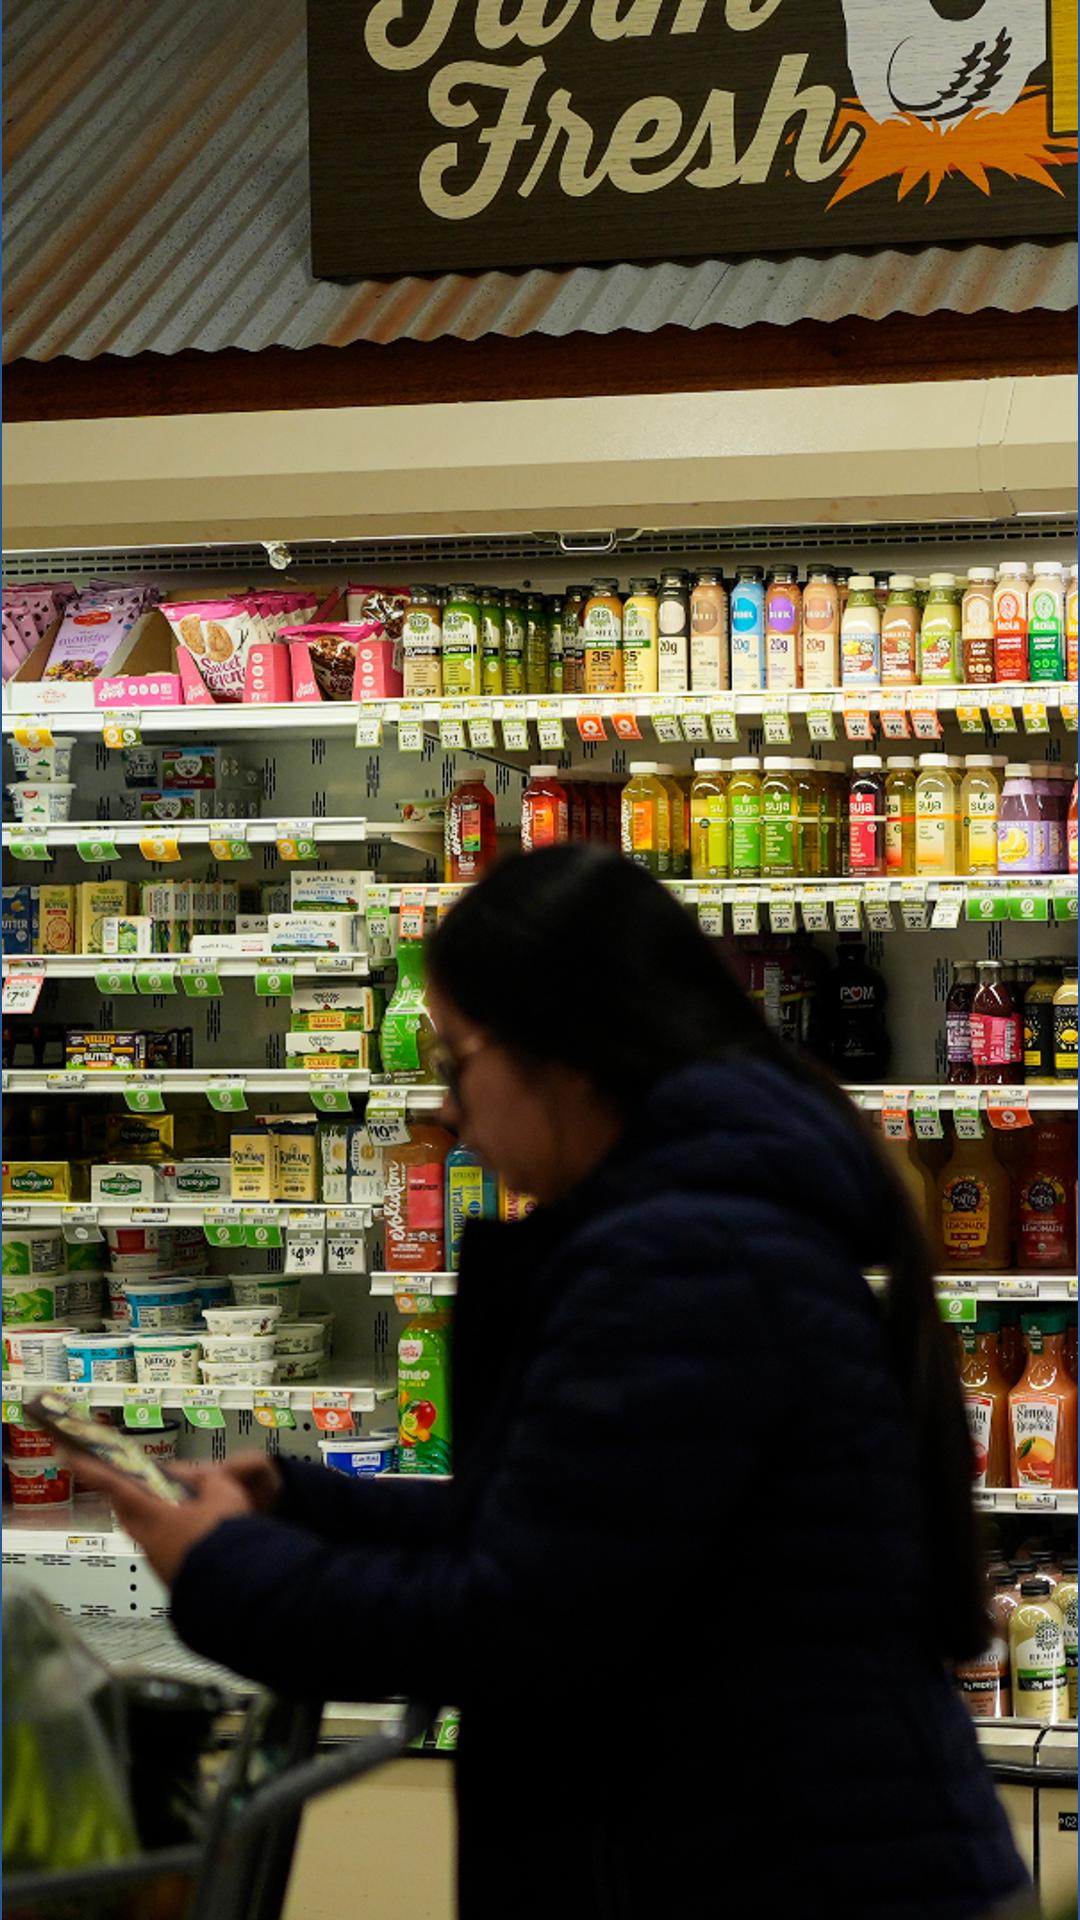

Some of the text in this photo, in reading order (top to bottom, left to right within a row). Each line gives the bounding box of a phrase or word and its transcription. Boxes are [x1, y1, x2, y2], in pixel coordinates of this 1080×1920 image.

[418, 53, 868, 220] Fresh
[770, 638, 788, 653] 20g
[806, 638, 825, 652] 20g
[200, 654, 243, 675] Sweet
[765, 801, 791, 814] suja
[850, 802, 872, 814] suja
[918, 801, 942, 814] suja
[970, 802, 995, 814] suja
[2, 919, 28, 930] UTTER
[840, 986, 876, 1001] POM
[384, 1160, 407, 1242] evolution
[945, 1221, 987, 1232] LEMONADE
[1022, 1223, 1063, 1233] LEMONADE
[398, 1369, 430, 1382] ango
[1017, 1403, 1054, 1422] Simply
